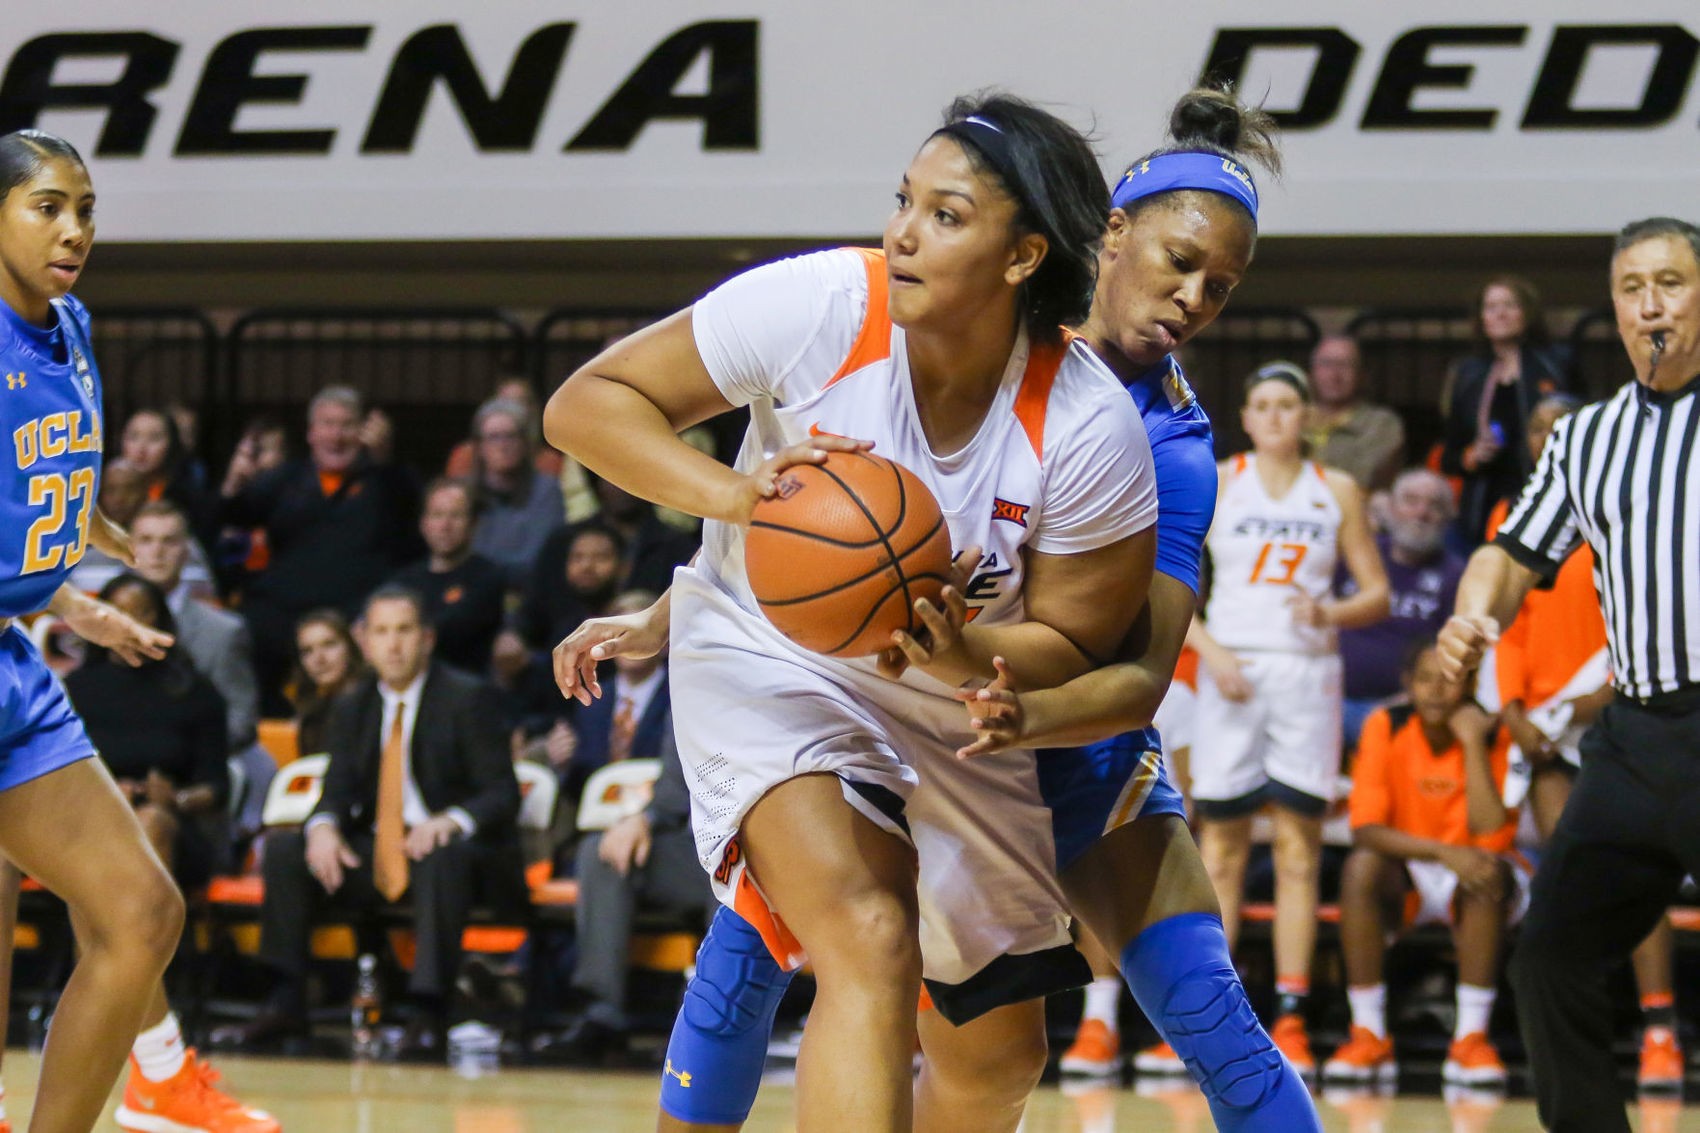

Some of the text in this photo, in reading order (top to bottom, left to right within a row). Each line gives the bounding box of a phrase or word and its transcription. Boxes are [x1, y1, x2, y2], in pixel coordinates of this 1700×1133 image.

[0, 19, 760, 157] RENA
[21, 467, 96, 575] 23
[1248, 543, 1308, 585] 13
